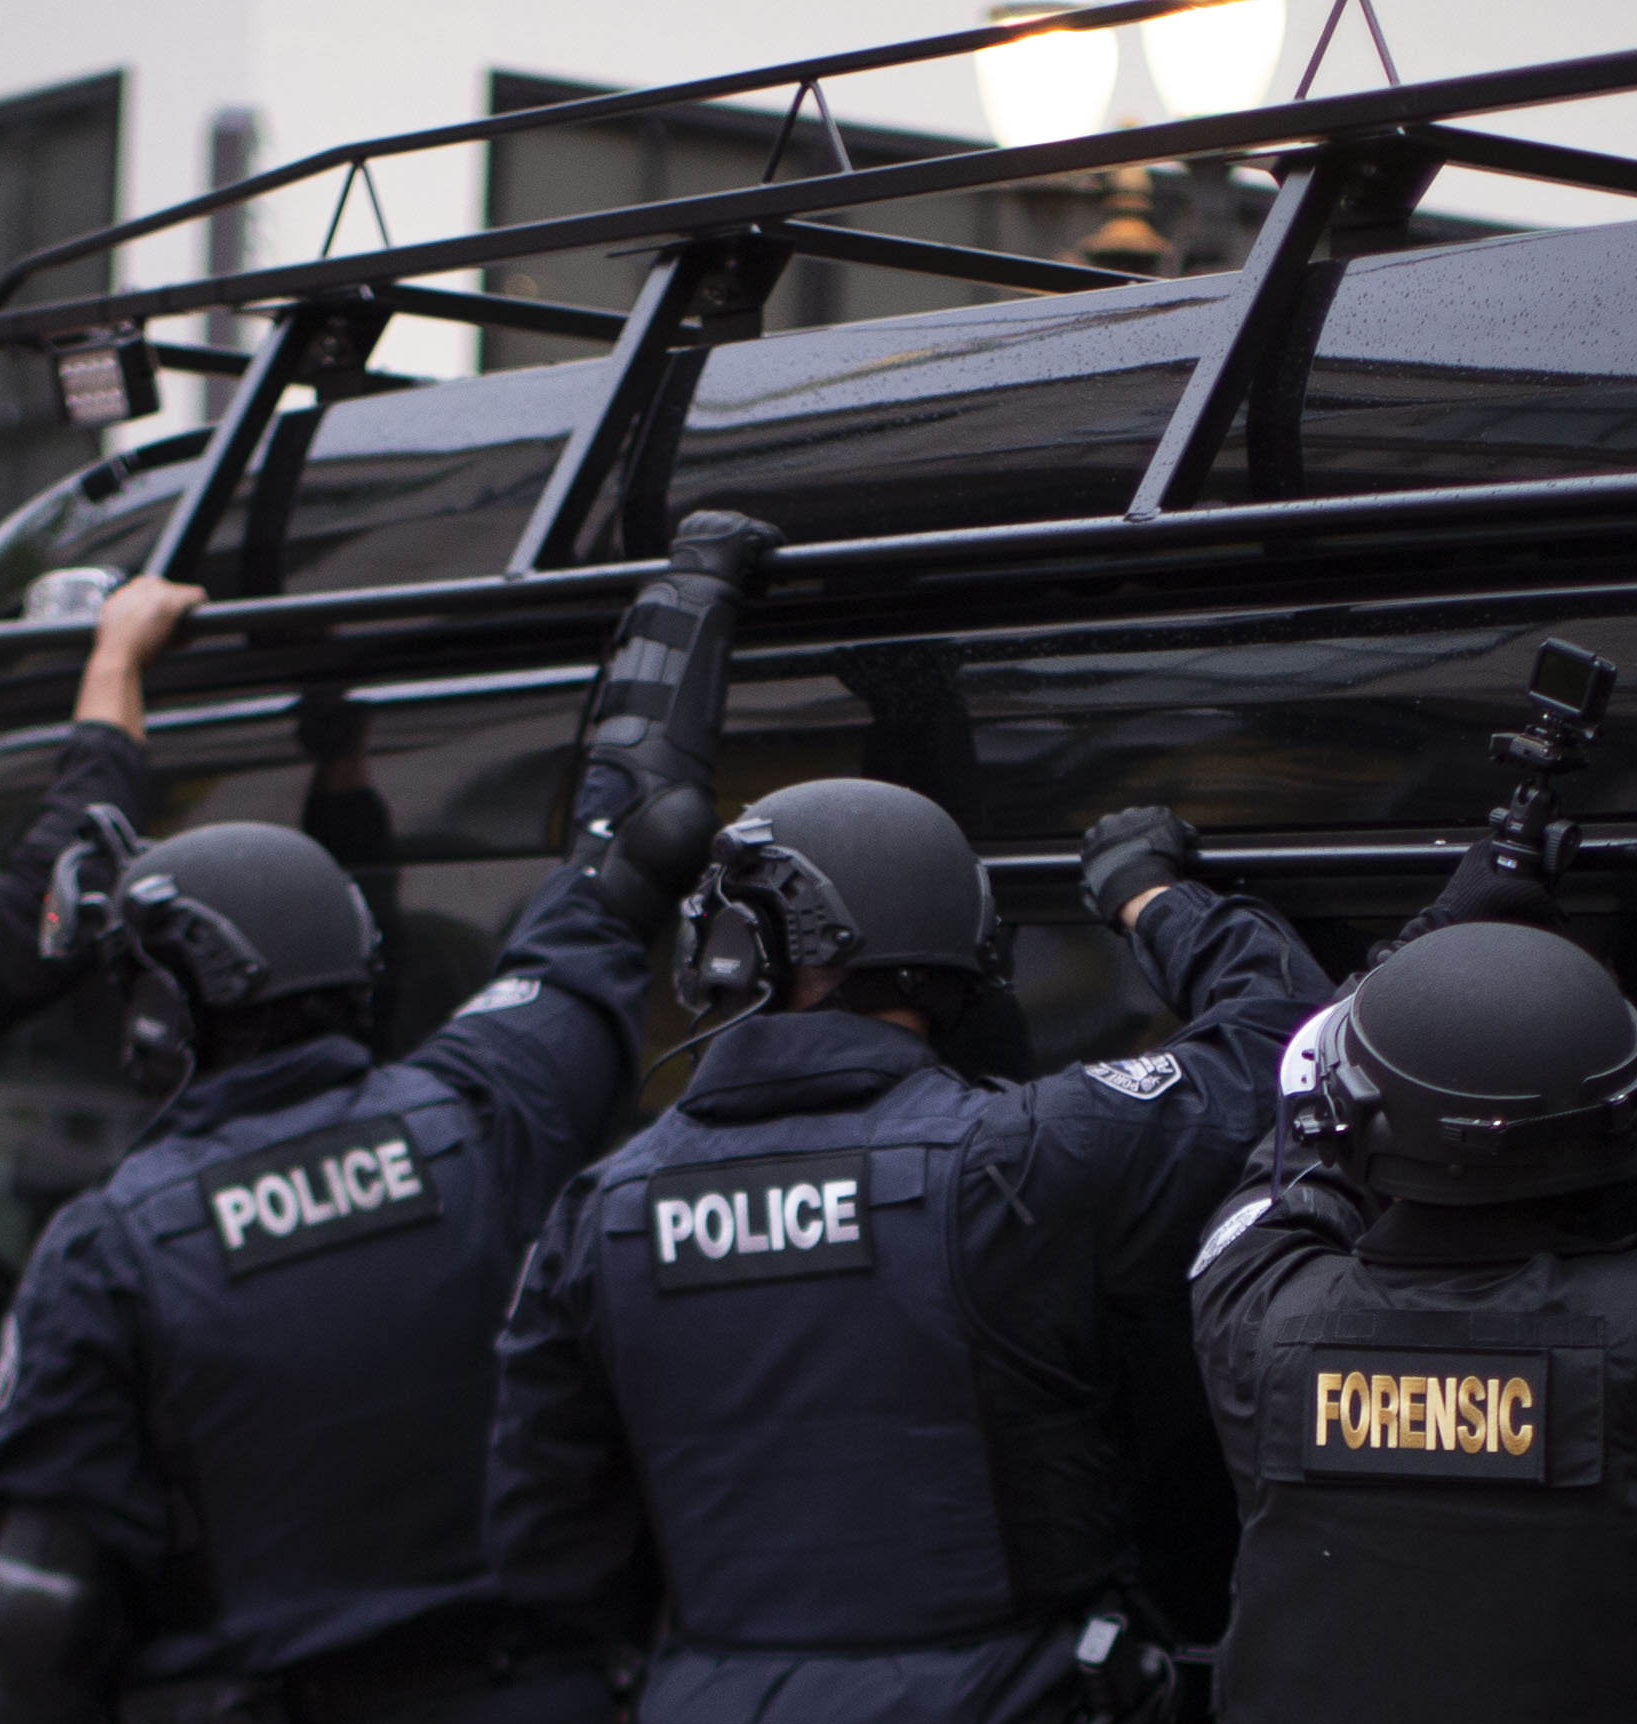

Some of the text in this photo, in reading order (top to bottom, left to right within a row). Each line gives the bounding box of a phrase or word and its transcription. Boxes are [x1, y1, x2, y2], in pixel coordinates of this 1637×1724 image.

[214, 1139, 423, 1249] POLICE
[657, 1180, 860, 1263] POLICE
[1315, 1371, 1533, 1456] FORENSIC
